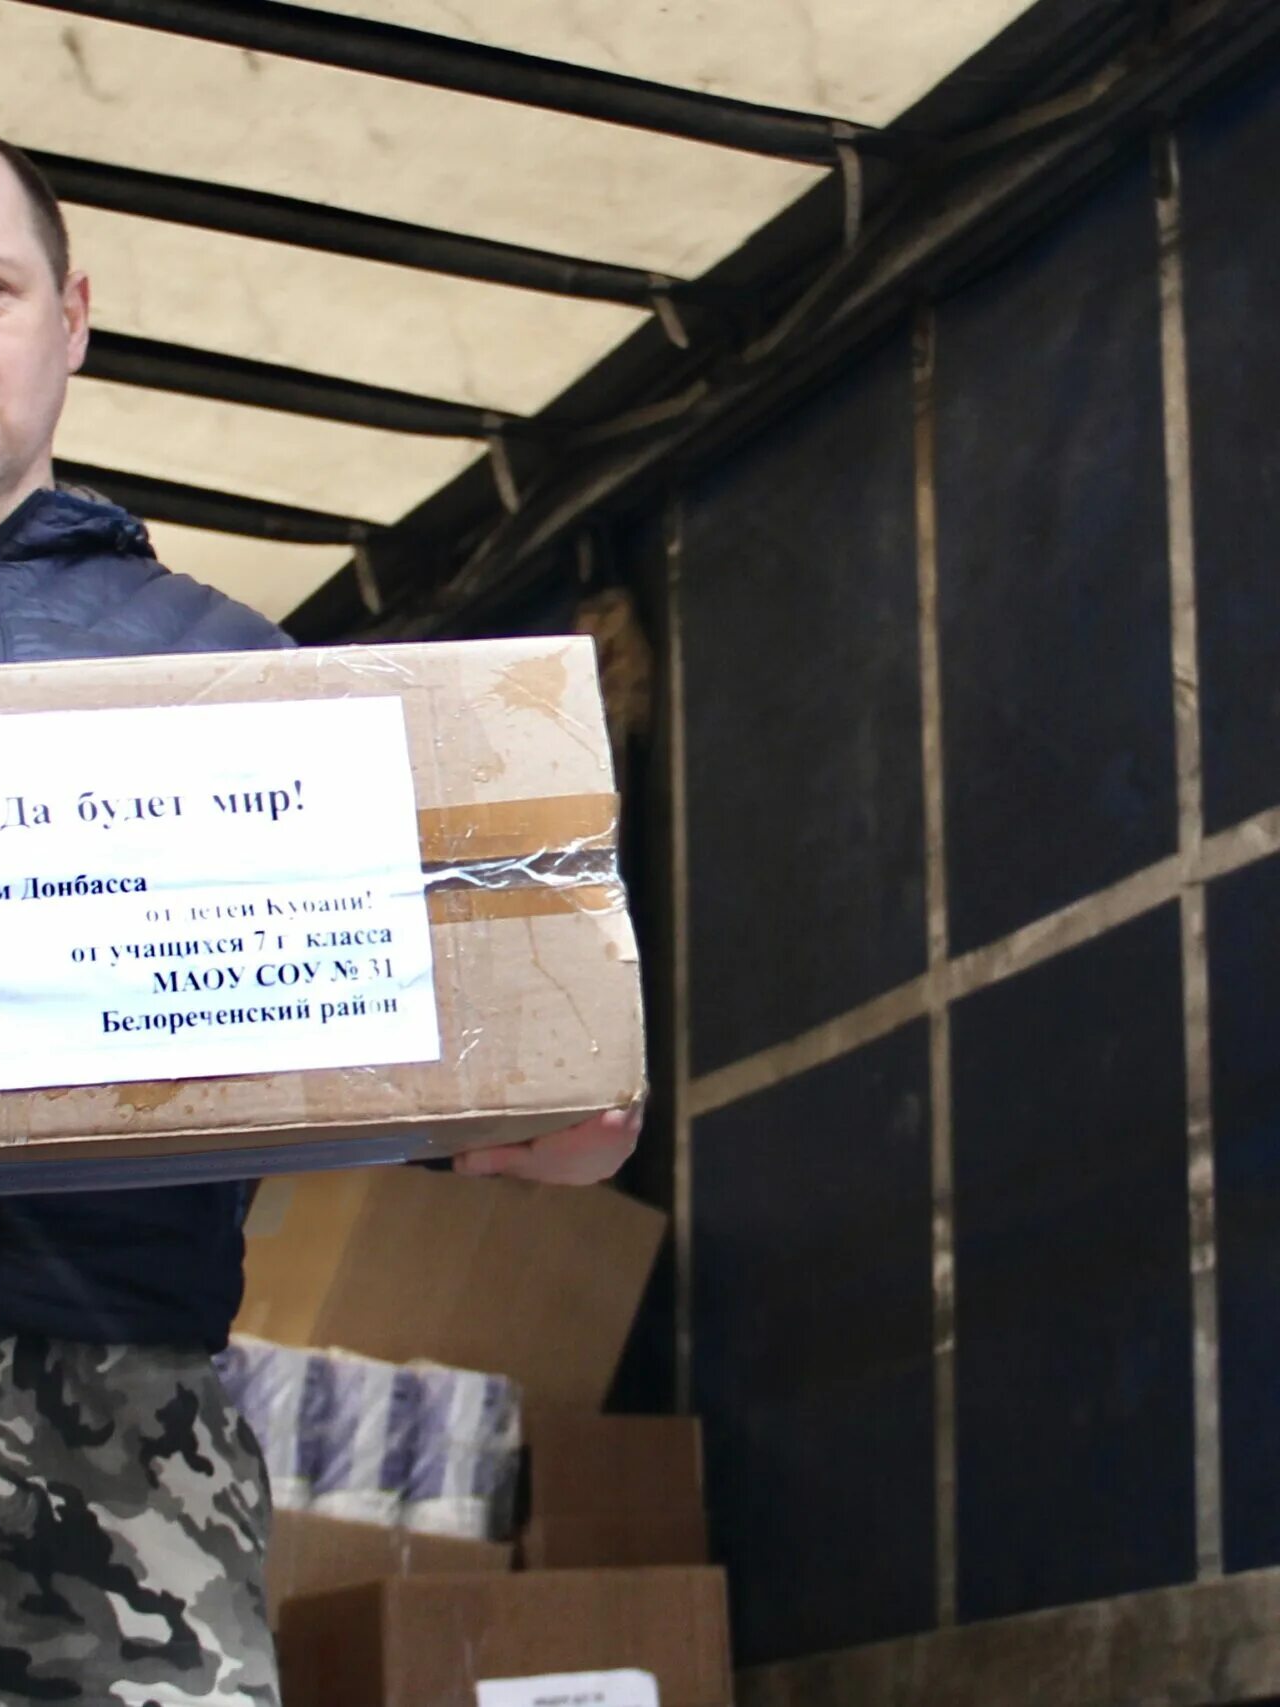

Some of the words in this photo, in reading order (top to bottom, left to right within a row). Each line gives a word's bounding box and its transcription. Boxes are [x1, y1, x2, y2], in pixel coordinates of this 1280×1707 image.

[0, 796, 51, 830] Да
[77, 791, 184, 829] будет
[212, 779, 304, 821] мир!
[21, 874, 147, 900] Донбасса
[146, 908, 171, 922] от
[72, 947, 97, 963] от
[110, 937, 244, 967] учащихся
[254, 930, 265, 951] 7
[306, 927, 393, 948] класса
[152, 966, 246, 995] МАОУ
[256, 961, 321, 987] СОУ
[330, 959, 359, 982] №
[368, 957, 393, 980] 31
[102, 998, 311, 1034] Белореченский
[320, 994, 398, 1024] район
